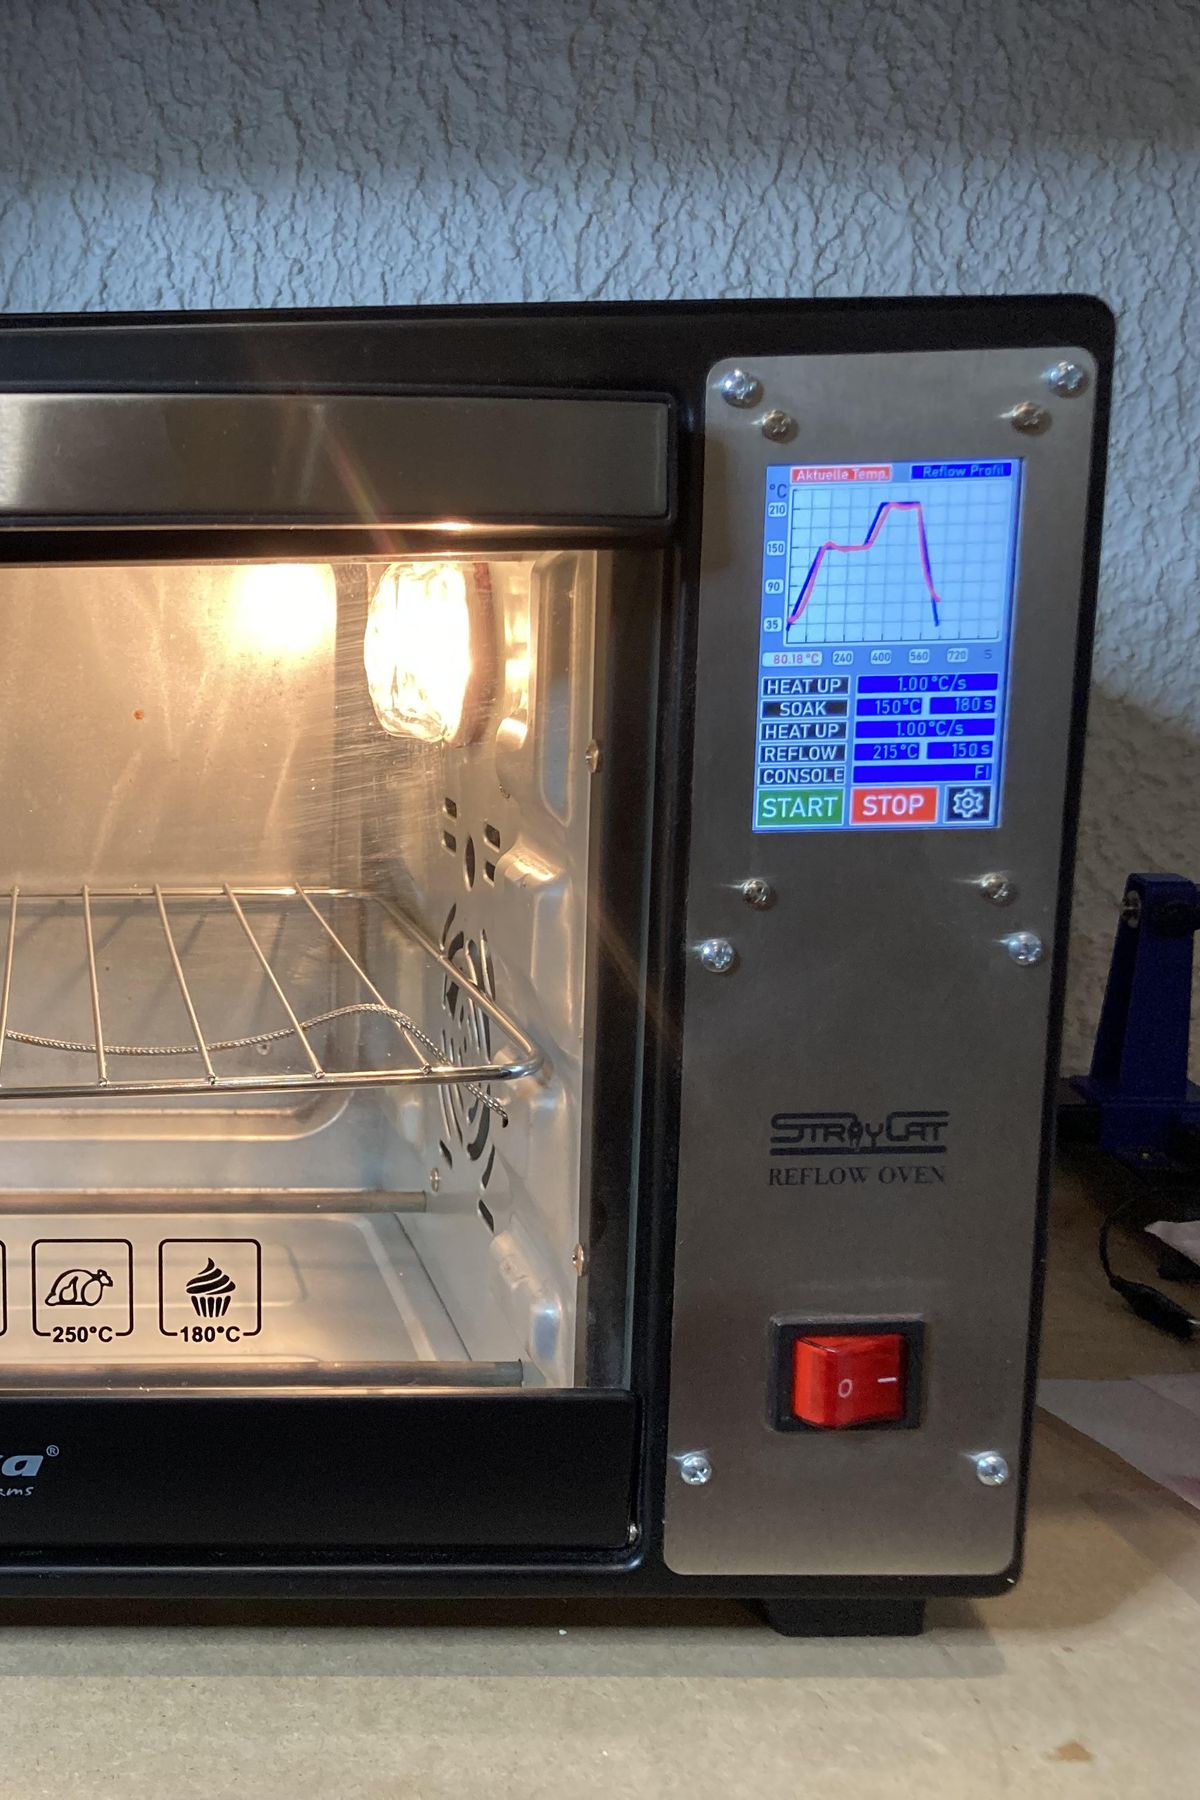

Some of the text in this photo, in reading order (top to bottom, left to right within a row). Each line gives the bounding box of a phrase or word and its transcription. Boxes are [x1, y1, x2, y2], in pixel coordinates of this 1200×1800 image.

[796, 470, 848, 481] Aktuelle
[922, 466, 966, 478] Reflow
[769, 504, 786, 515] 210
[767, 543, 785, 553] 150
[767, 581, 780, 592] 90
[765, 620, 779, 630] 35
[910, 650, 929, 661] 560
[948, 649, 966, 660] 720
[767, 678, 841, 694] HEAT UP
[780, 701, 827, 716] SOAK
[765, 724, 839, 739] HEAT UP
[764, 746, 837, 762] REFLOW
[763, 768, 844, 784] CONSOLE
[762, 797, 839, 818] START
[862, 794, 925, 816] STOP
[768, 1165, 948, 1186] REFLOW OVEN
[52, 1327, 114, 1343] 250°C
[179, 1326, 241, 1342] 180°C
